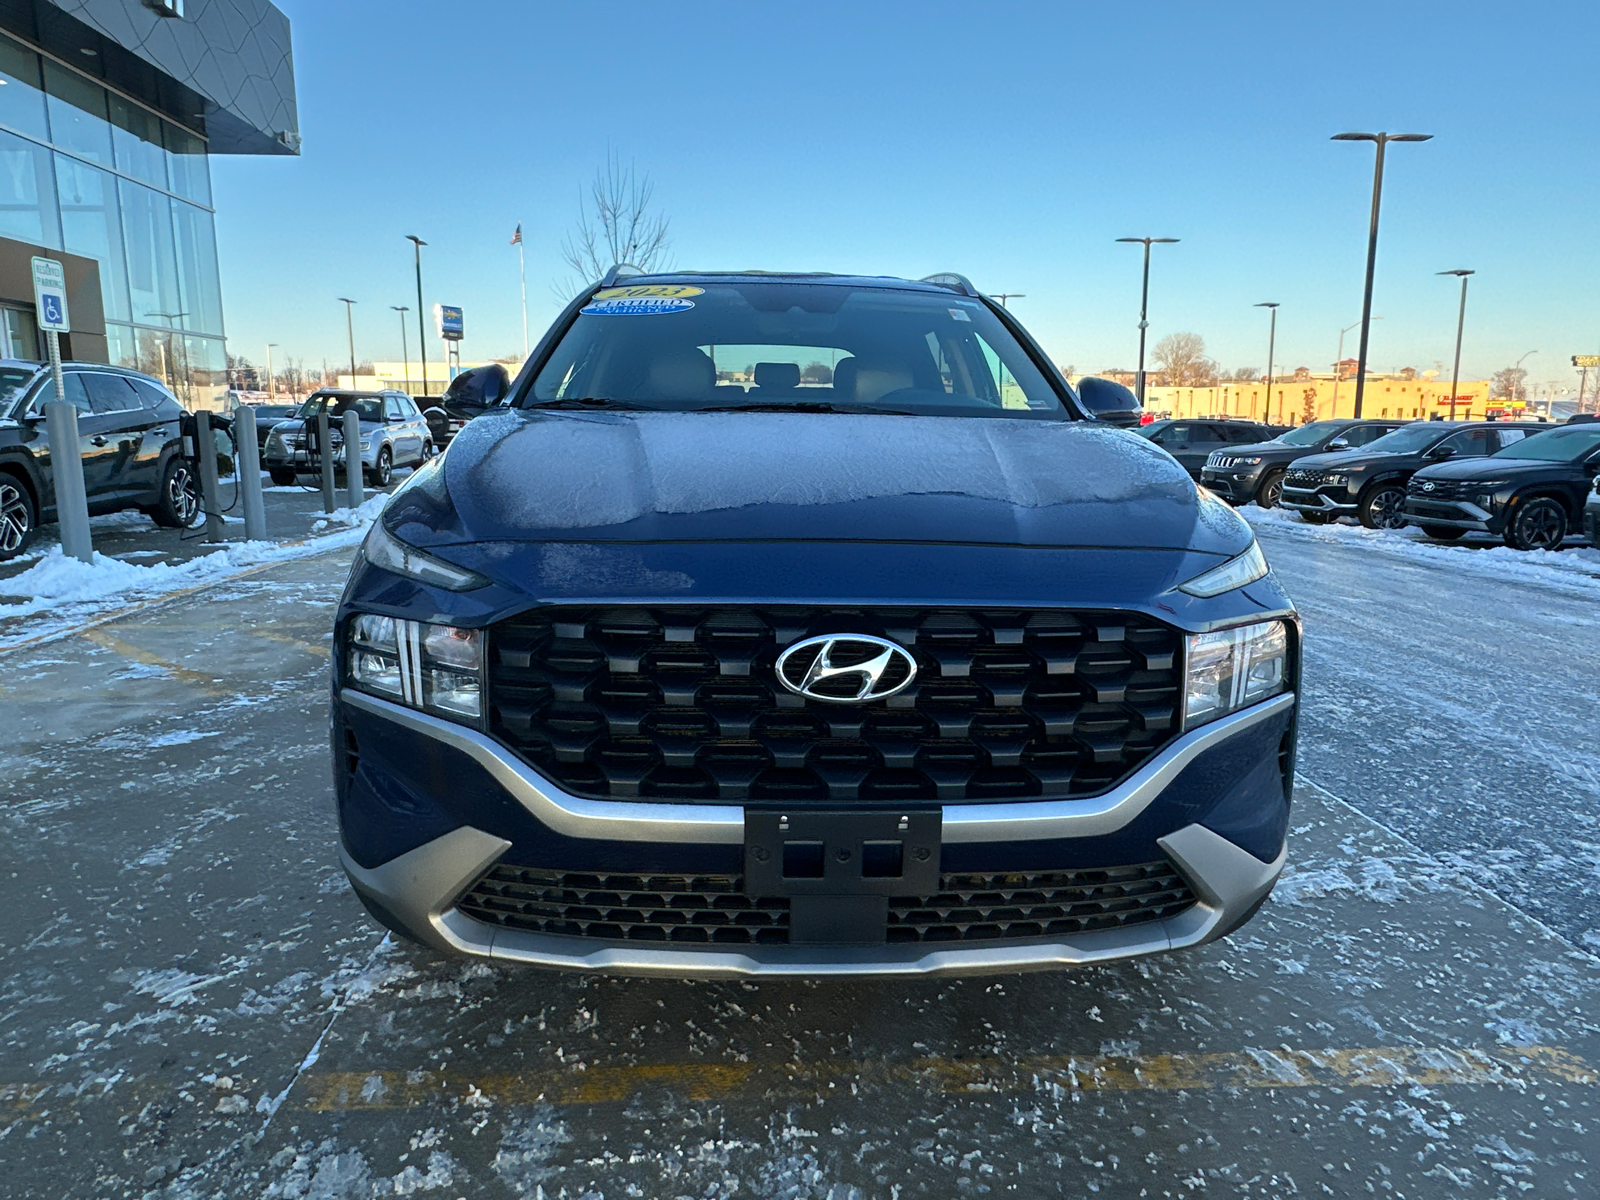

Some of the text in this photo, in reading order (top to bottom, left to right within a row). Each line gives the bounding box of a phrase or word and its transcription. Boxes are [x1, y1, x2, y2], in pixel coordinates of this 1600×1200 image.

[36, 265, 60, 277] RESERVED
[37, 277, 63, 289] PARKING
[608, 287, 686, 298] 2023
[595, 299, 682, 308] CERTIFIED
